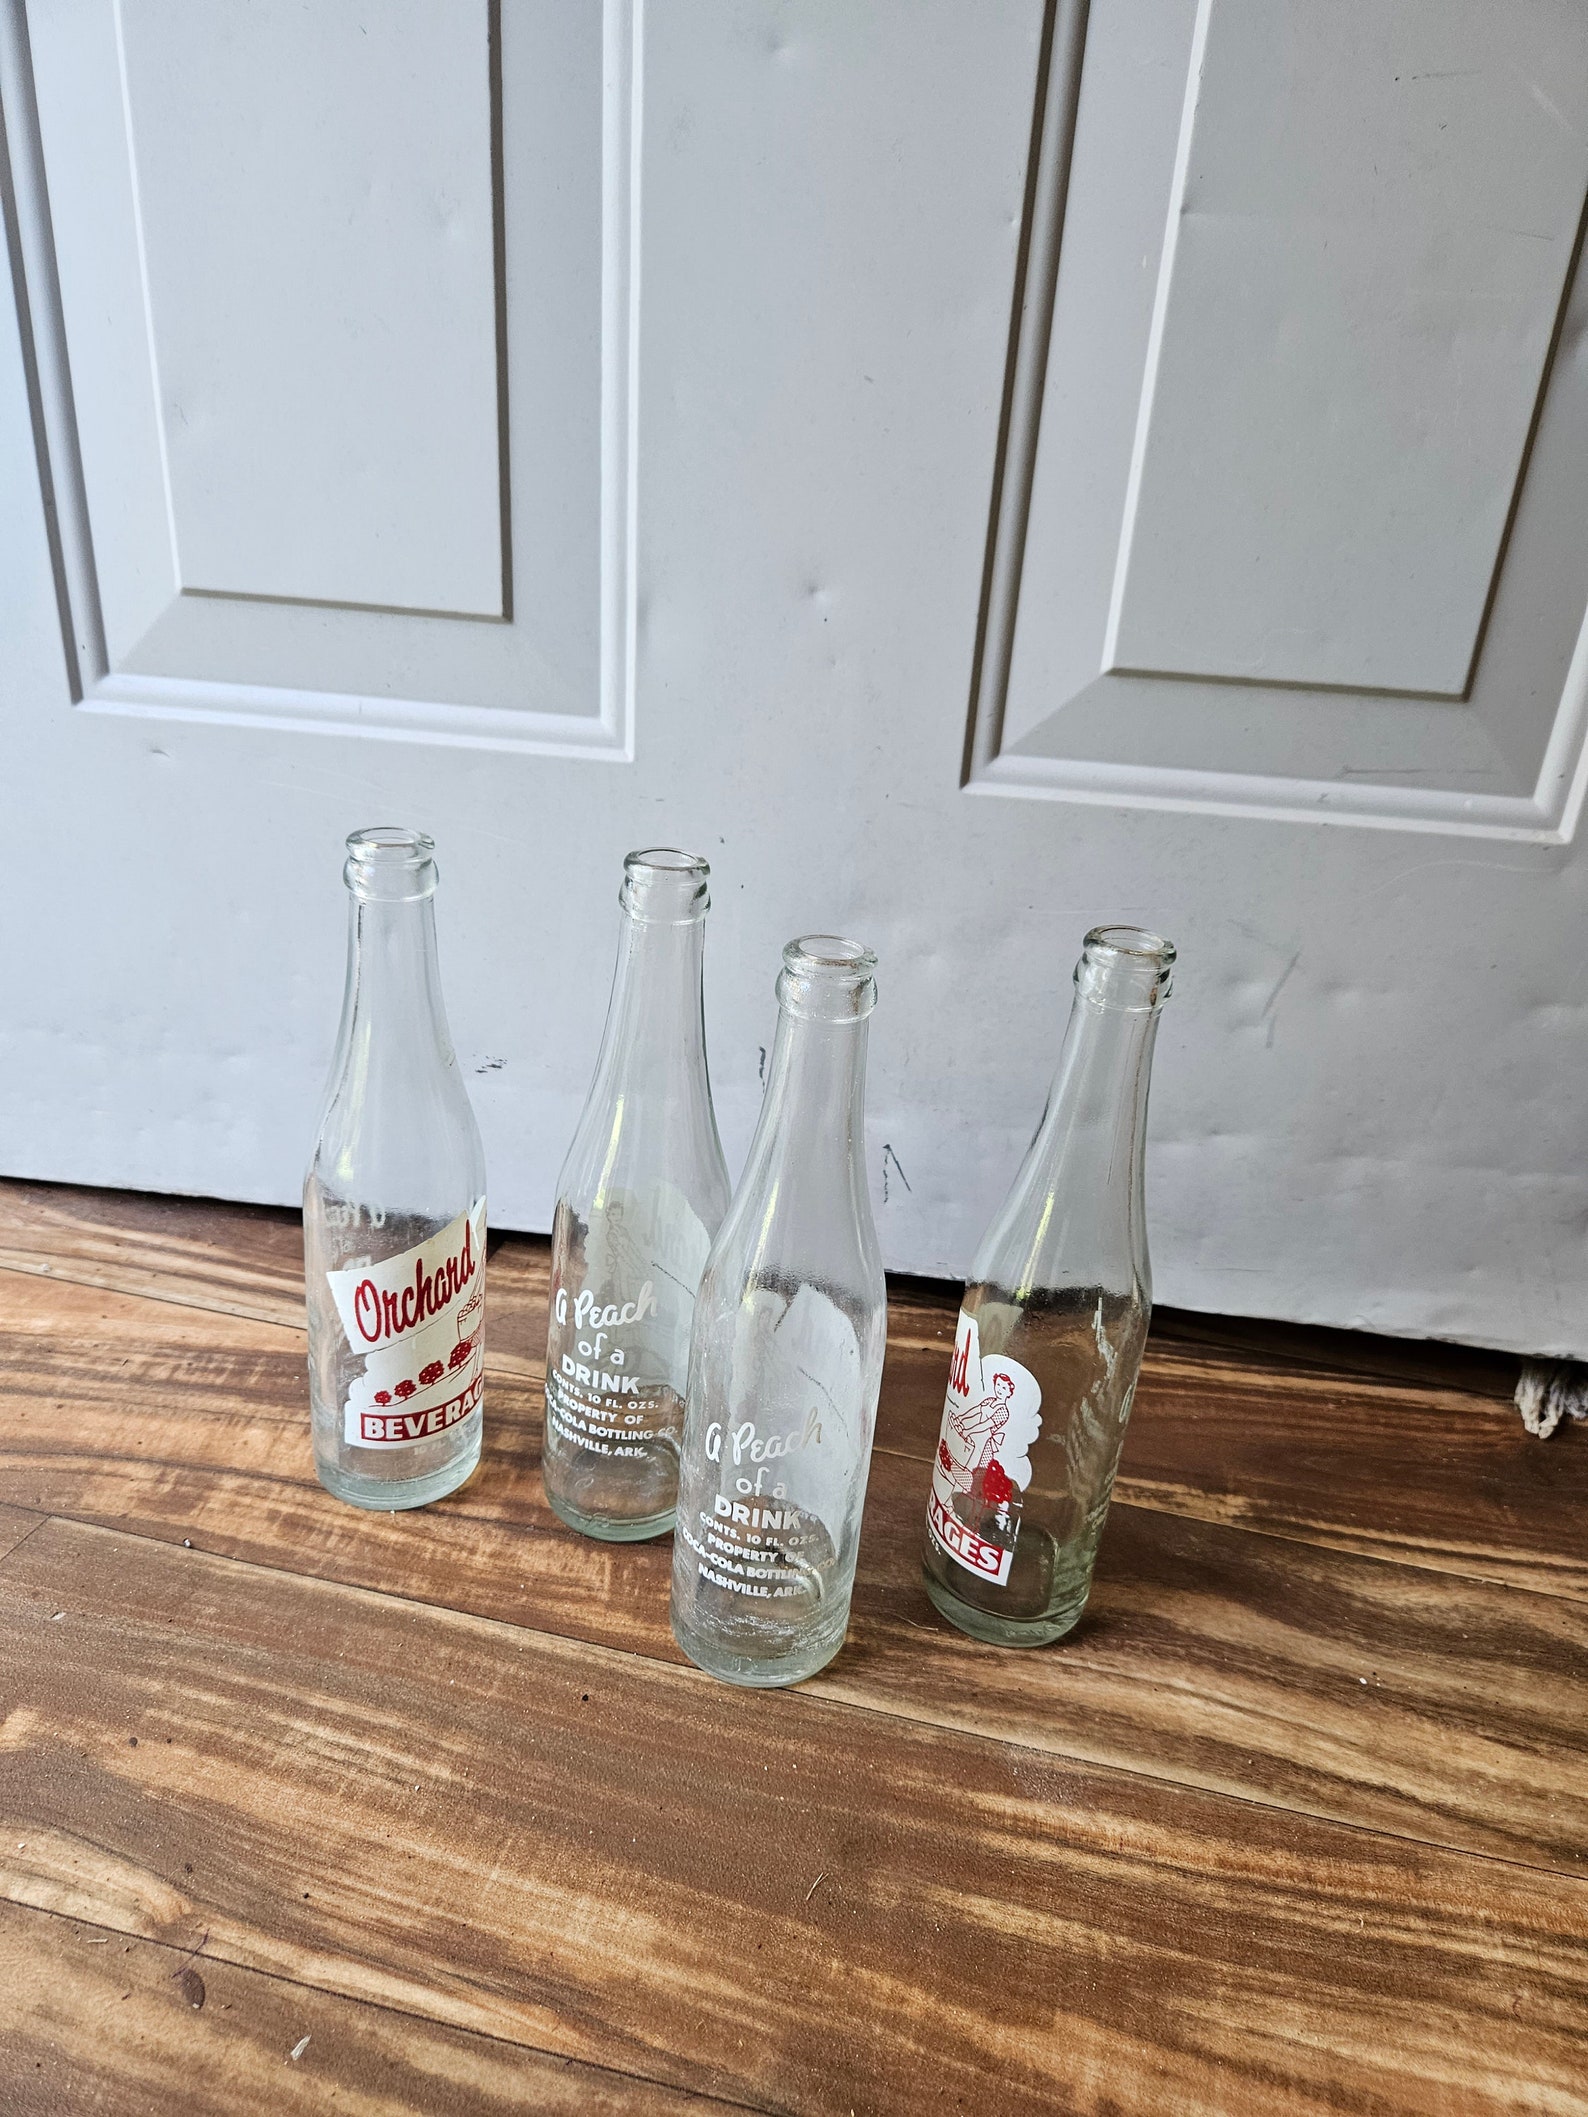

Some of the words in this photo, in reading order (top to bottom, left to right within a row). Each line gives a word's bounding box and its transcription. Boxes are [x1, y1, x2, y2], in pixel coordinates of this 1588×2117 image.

[354, 1217, 476, 1343] Orchard
[574, 1280, 658, 1330] Peach
[578, 1332, 608, 1360] of
[610, 1349, 625, 1366] a
[552, 1369, 584, 1399] CONTS.
[588, 1392, 602, 1405] 10
[605, 1398, 623, 1409] FL.
[627, 1401, 659, 1410] OZS.
[562, 1353, 641, 1395] DRINK
[557, 1386, 618, 1423] PROPERTY
[624, 1415, 644, 1425] OF
[552, 1416, 613, 1456] NASHVILLE,
[588, 1423, 655, 1441] BOTTLING
[731, 1406, 823, 1466] Peach
[735, 1466, 770, 1497] of
[773, 1482, 787, 1500] a
[700, 1511, 741, 1541] CONTS.
[746, 1533, 761, 1546] 10
[765, 1536, 784, 1547] FL.
[788, 1534, 820, 1546] OZS.
[714, 1494, 802, 1531] DRINK
[682, 1526, 745, 1576] COCA-COLA
[707, 1532, 779, 1563] PROPERTY
[784, 1550, 805, 1563] OF
[698, 1562, 772, 1599] NASHVILLE,
